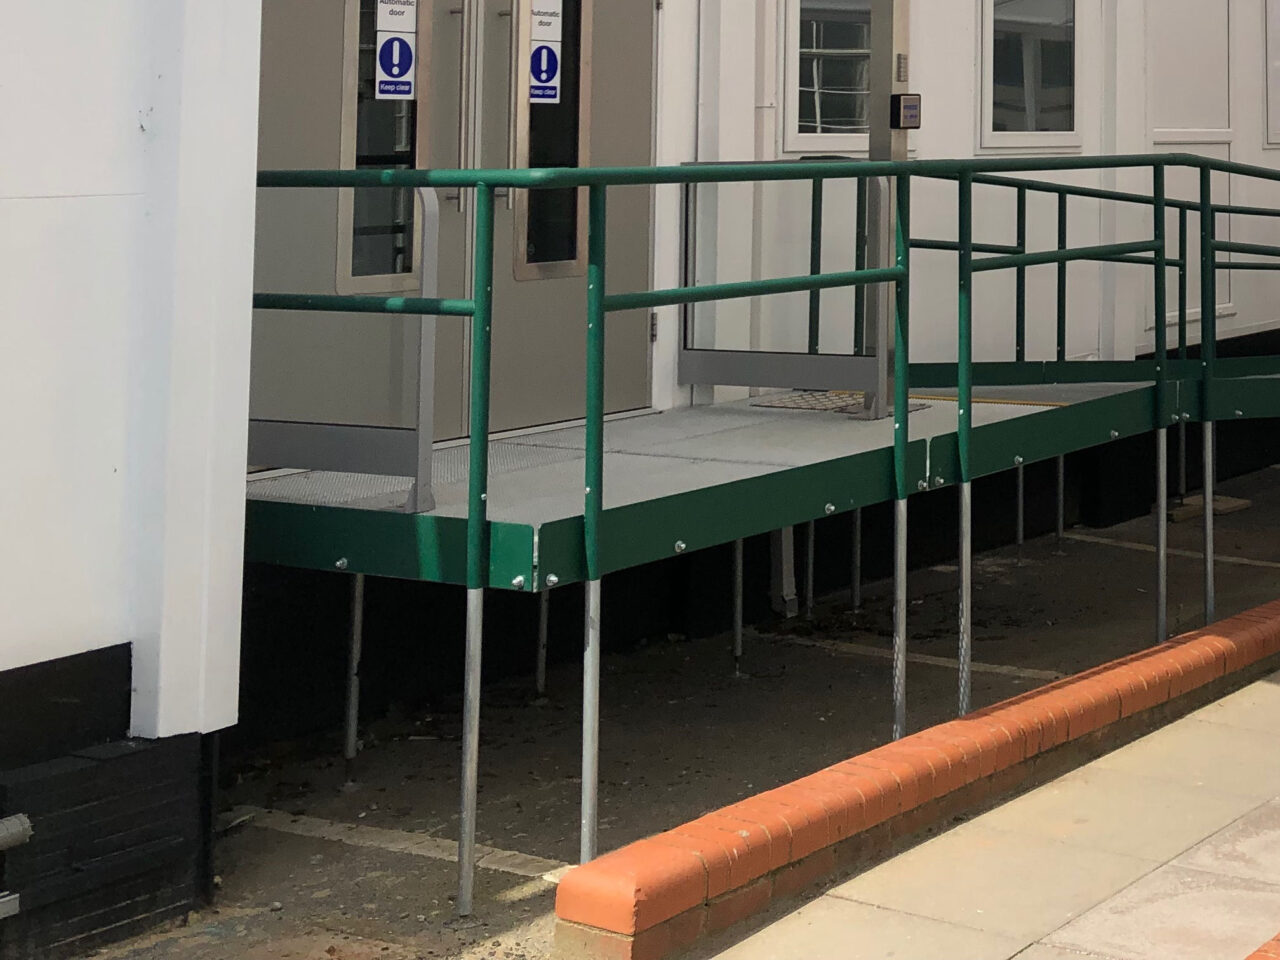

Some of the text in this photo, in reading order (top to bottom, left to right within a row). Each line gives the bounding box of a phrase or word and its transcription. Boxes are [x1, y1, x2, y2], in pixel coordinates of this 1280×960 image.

[388, 8, 405, 17] door
[538, 19, 552, 27] door
[380, 83, 395, 92] Keep
